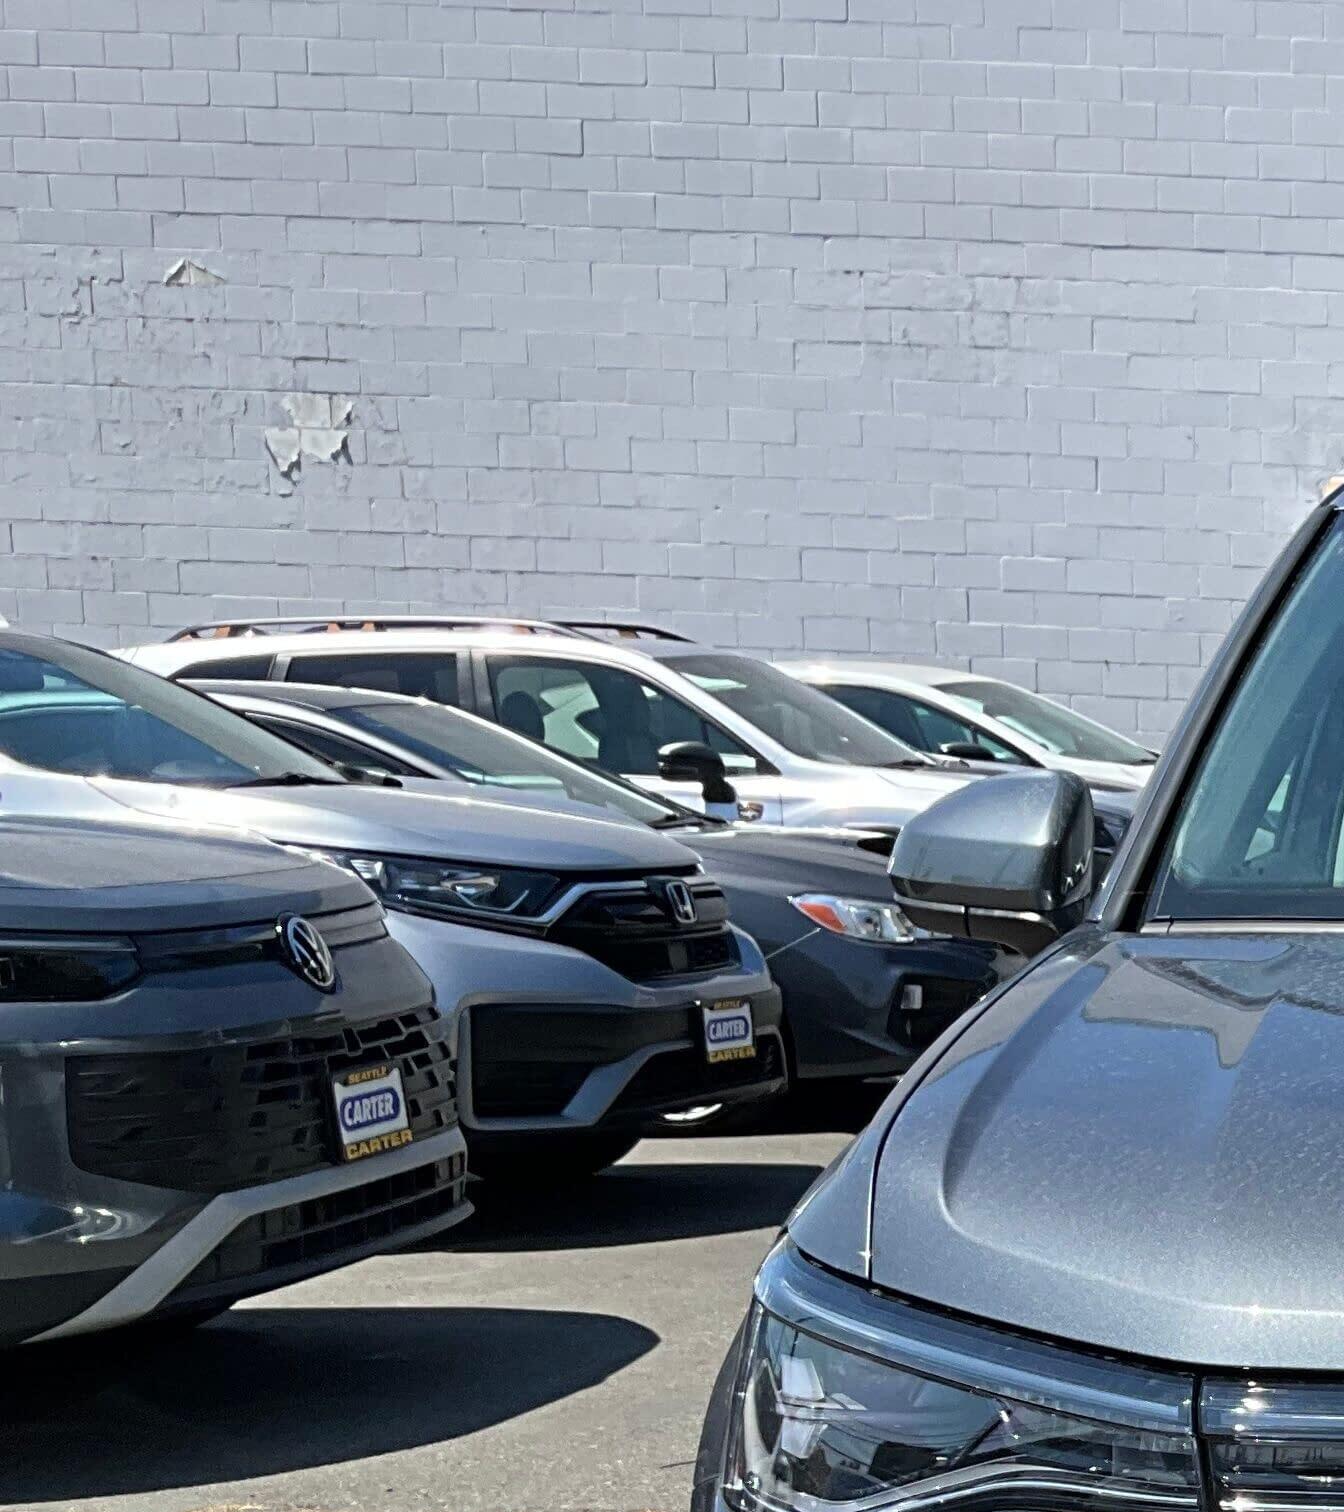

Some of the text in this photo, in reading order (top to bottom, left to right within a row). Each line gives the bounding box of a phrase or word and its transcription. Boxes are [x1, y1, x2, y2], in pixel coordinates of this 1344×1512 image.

[709, 1019, 746, 1041] CARTER
[347, 1065, 388, 1084] SEATTLE
[343, 1092, 395, 1126] CARTER
[345, 1128, 414, 1160] CARTER
